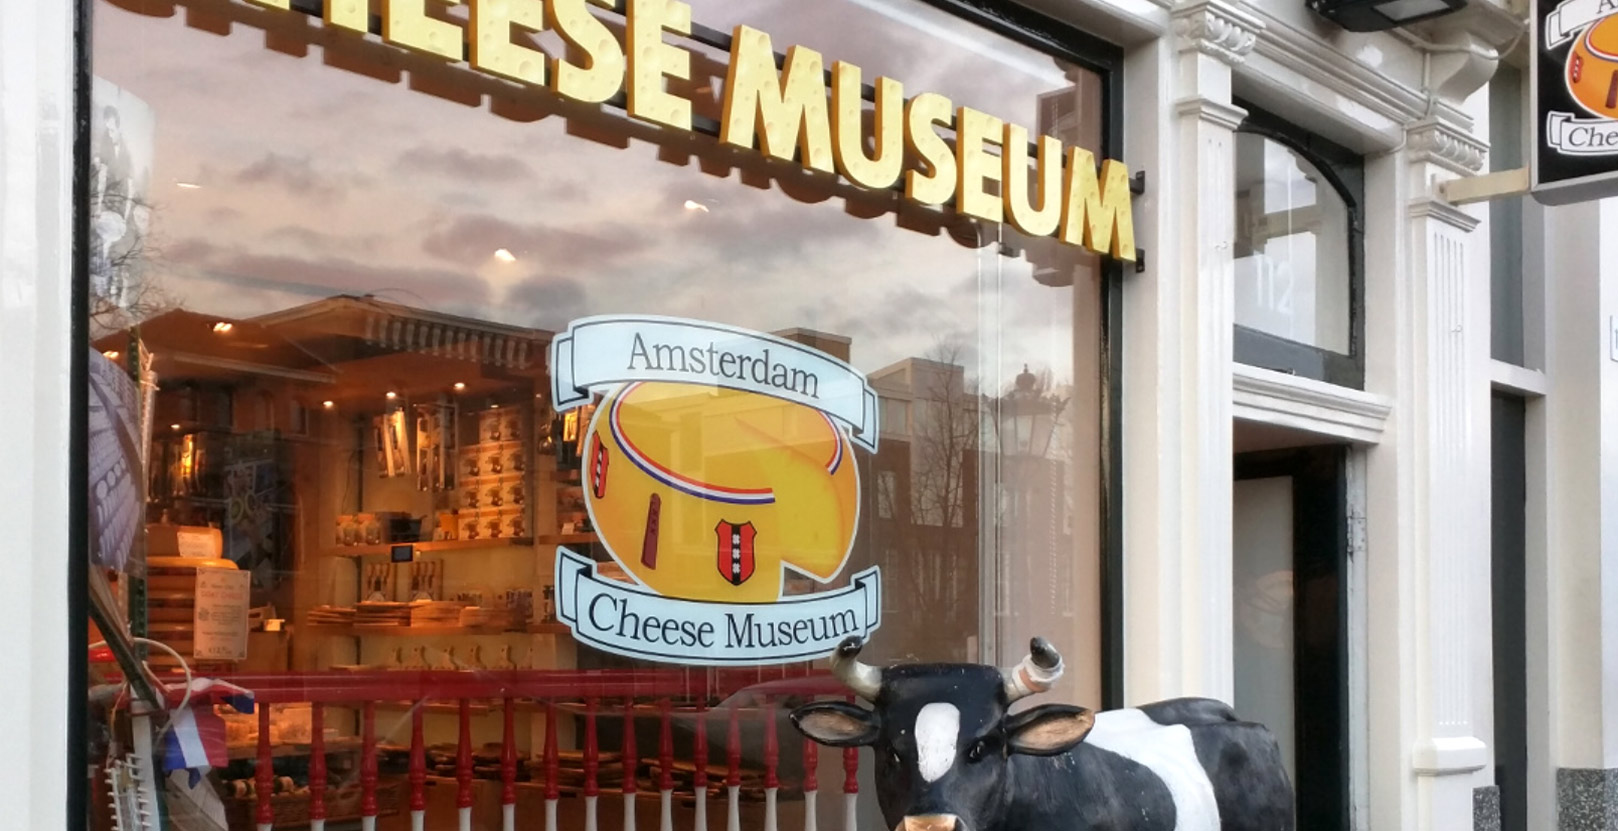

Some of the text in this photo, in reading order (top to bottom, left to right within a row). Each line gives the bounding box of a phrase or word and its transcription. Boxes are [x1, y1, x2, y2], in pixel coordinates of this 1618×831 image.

[719, 25, 1136, 262] MUSEUM
[1254, 254, 1294, 315] 112
[627, 332, 820, 399] Amsterdam
[588, 593, 860, 649] Cheese Museum
